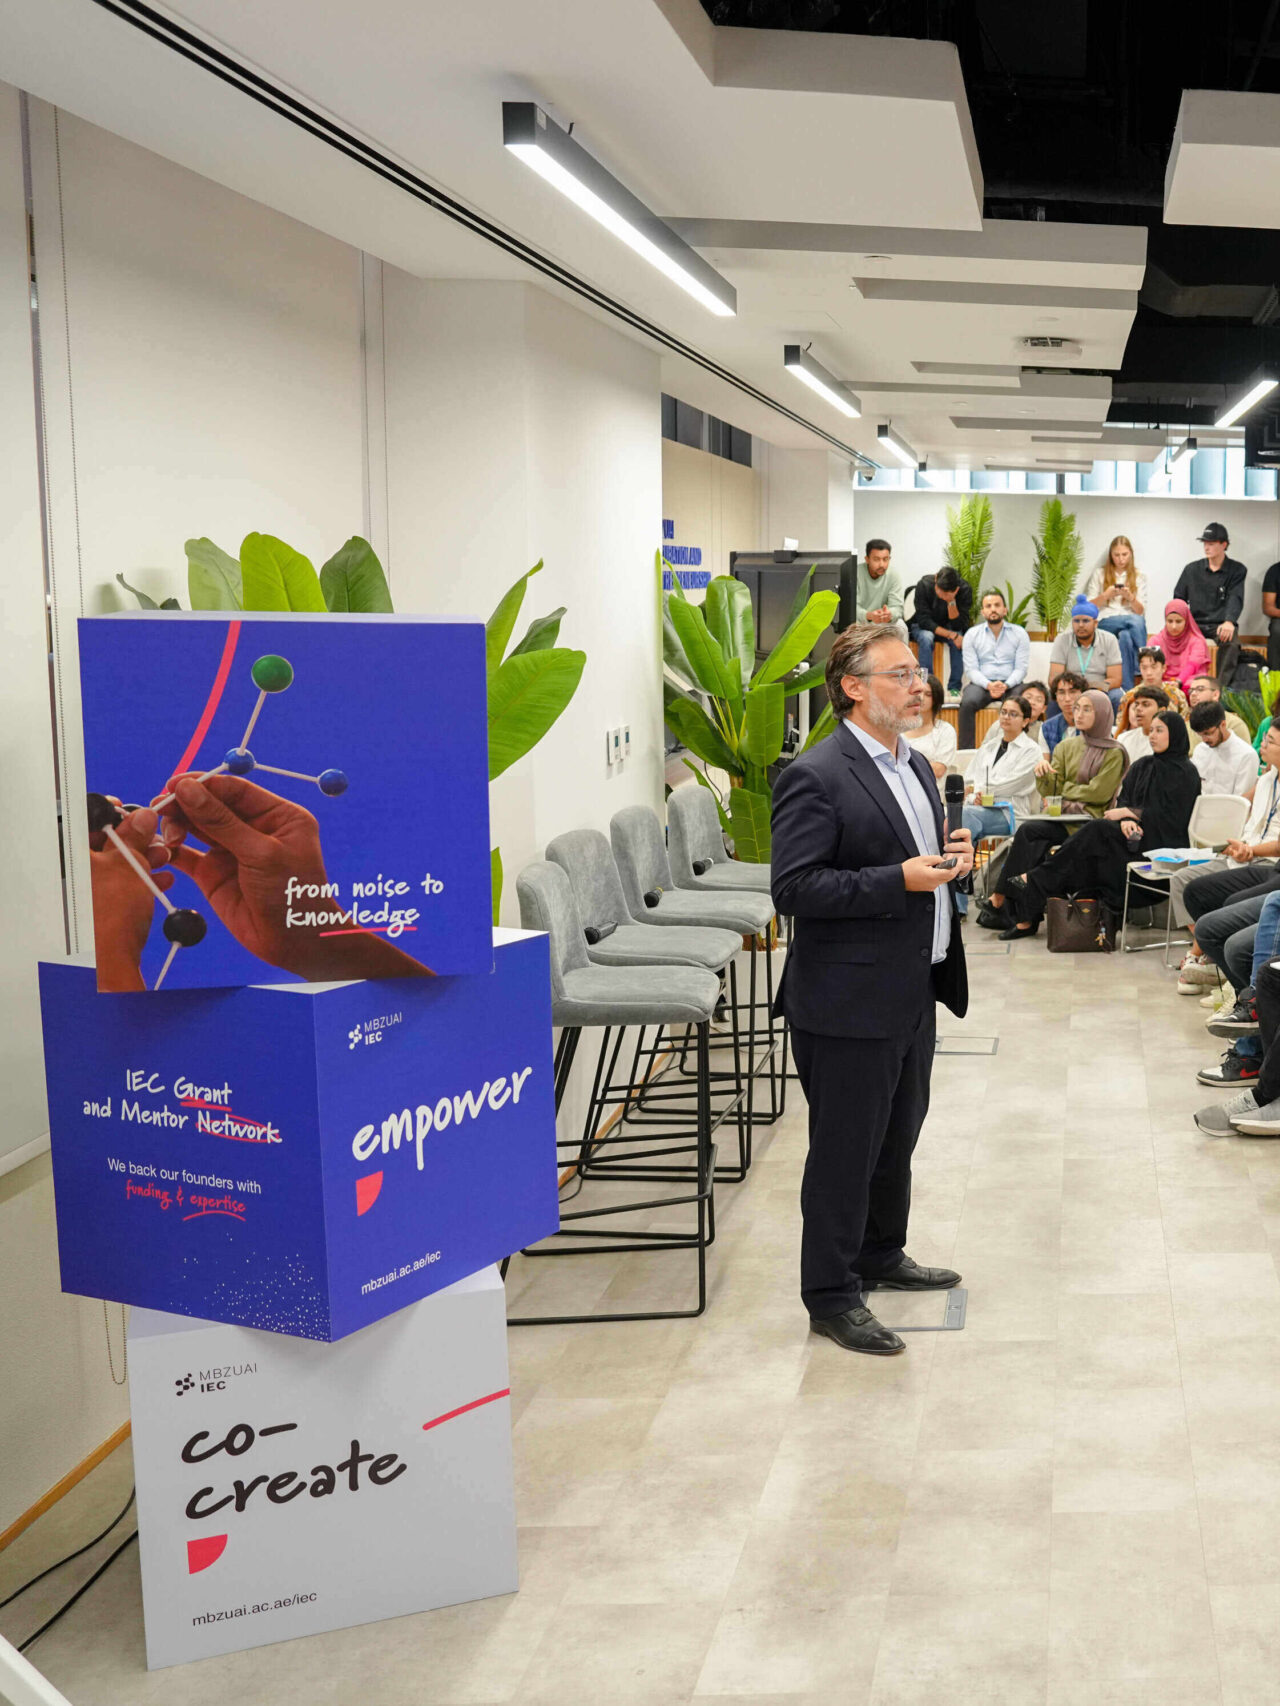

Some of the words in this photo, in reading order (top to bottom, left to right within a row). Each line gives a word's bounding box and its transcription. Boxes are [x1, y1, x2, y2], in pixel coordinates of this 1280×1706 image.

[284, 876, 340, 906] from
[352, 873, 410, 898] noise
[420, 872, 444, 895] to
[286, 901, 420, 938] knowledge
[364, 1011, 402, 1033] MBZUAI
[364, 1031, 383, 1045] IEC
[126, 1069, 165, 1093] IEC
[173, 1076, 232, 1104] Grant
[83, 1096, 112, 1118] and
[121, 1098, 189, 1129] Mentor
[197, 1110, 283, 1144] Network
[352, 1066, 533, 1171] empower
[107, 1157, 126, 1172] We
[129, 1161, 157, 1178] back
[160, 1168, 180, 1181] our
[182, 1169, 234, 1190] founders
[236, 1179, 262, 1194] with
[126, 1179, 173, 1210] funding
[176, 1185, 184, 1207] &
[190, 1194, 246, 1213] expertise
[361, 1250, 441, 1296] mbzuai.ac.ae/iec
[199, 1363, 258, 1381] MBZUAI
[200, 1380, 227, 1393] IEC
[181, 1422, 298, 1464] co-
[185, 1439, 408, 1520] create
[192, 1592, 318, 1627] mbzuai.ac.ae/iec
